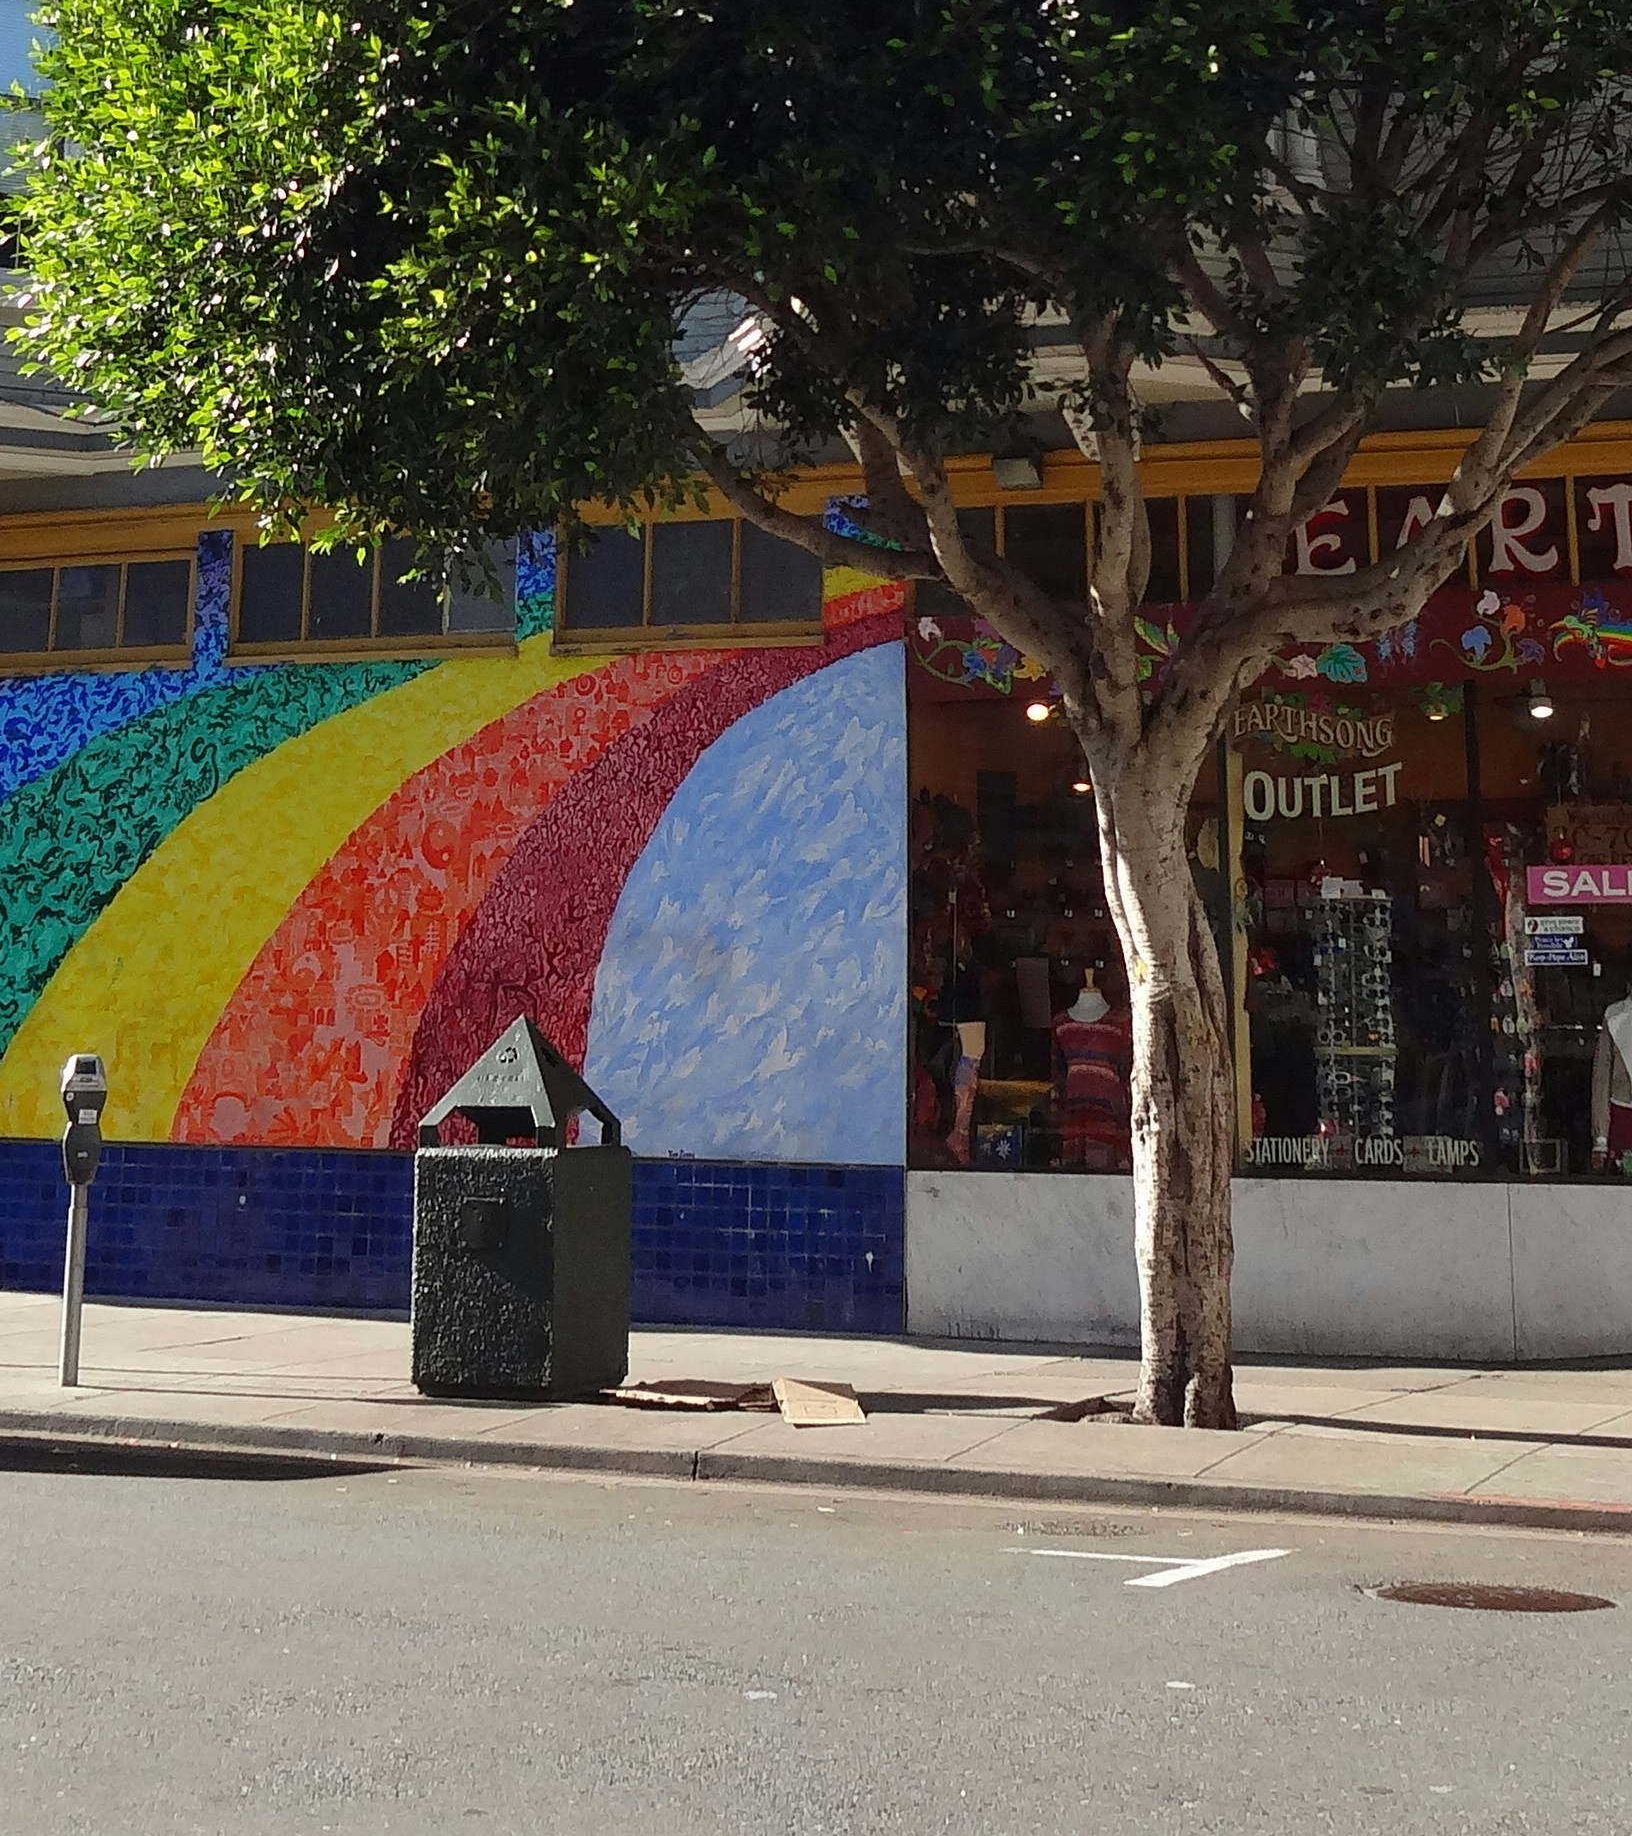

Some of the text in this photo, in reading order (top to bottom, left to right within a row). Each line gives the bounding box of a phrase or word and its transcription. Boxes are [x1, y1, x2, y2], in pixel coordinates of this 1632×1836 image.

[1234, 703, 1393, 758] EARTHSONG
[1243, 761, 1403, 821] OUTLET
[1245, 1136, 1480, 1166] STATIONERY CARDS LAMPS
